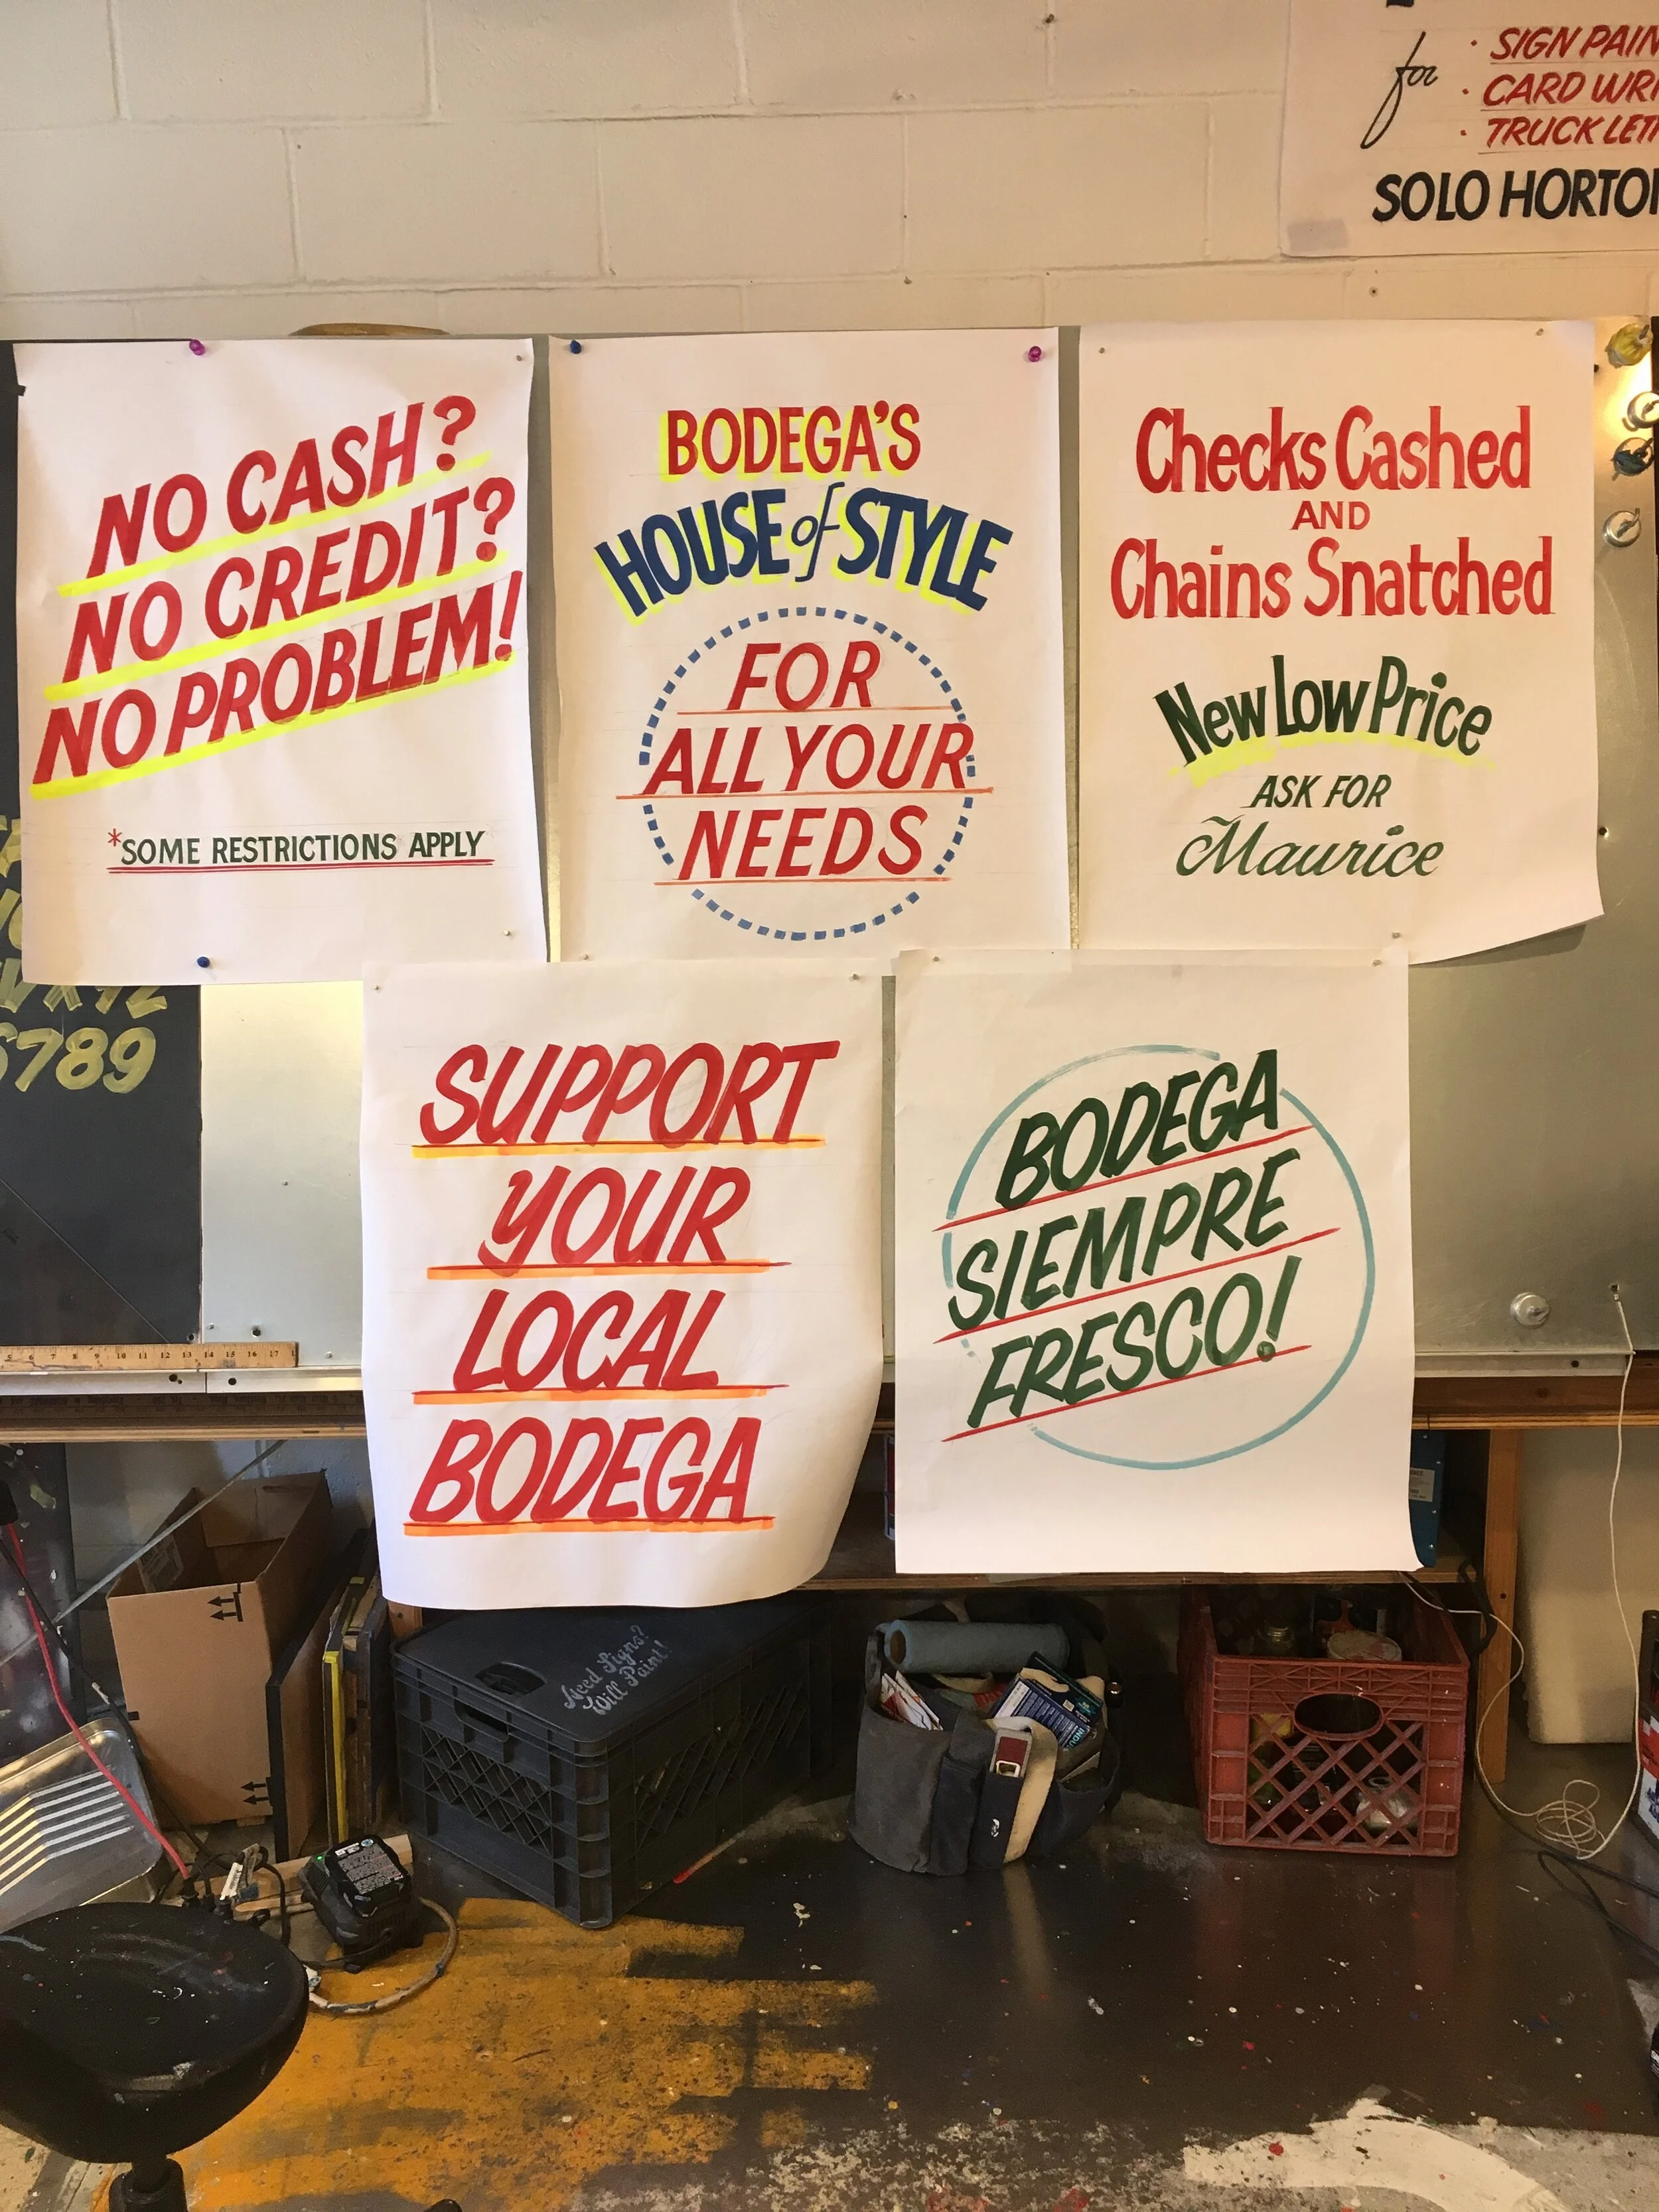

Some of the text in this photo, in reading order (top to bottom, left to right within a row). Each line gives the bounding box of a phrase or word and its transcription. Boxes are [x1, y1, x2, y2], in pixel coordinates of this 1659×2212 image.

[1490, 27, 1583, 60] SIGN
[1360, 31, 1438, 149] for
[1483, 72, 1587, 106] CARD
[1486, 115, 1605, 148] TRUCK
[1372, 169, 1490, 222] SOLO
[668, 400, 921, 476] BODEGA'S
[1136, 405, 1532, 493] Checks Cashed
[86, 474, 207, 579] NO
[595, 482, 1014, 617] HOUSE of STYLE
[1291, 500, 1371, 530] AND
[62, 477, 516, 684] NO CREDIT?
[1110, 536, 1555, 619] Chains Snatched
[33, 570, 523, 784] NO PROBLEM!
[727, 641, 882, 712] FOR
[1153, 655, 1492, 766] New Low Price
[642, 723, 974, 794] ALL YOUR
[1243, 774, 1392, 808] ASK FOR
[213, 832, 397, 863] RESTRICTIONS
[408, 830, 486, 859] APPLY
[680, 805, 928, 880] NEEDS
[1176, 814, 1445, 878] Maurice
[419, 1040, 840, 1148] SUPPORT
[995, 1049, 1278, 1210] BODEGA
[478, 1165, 751, 1276] YOUR
[948, 1149, 1301, 1331] SIEMPRE
[453, 1289, 726, 1391] LOCAL
[968, 1256, 1302, 1429] FRESCO!
[409, 1416, 762, 1526] BODEGA
[561, 1625, 649, 1709] Need Signs?
[583, 1640, 672, 1715] Will Paint!
